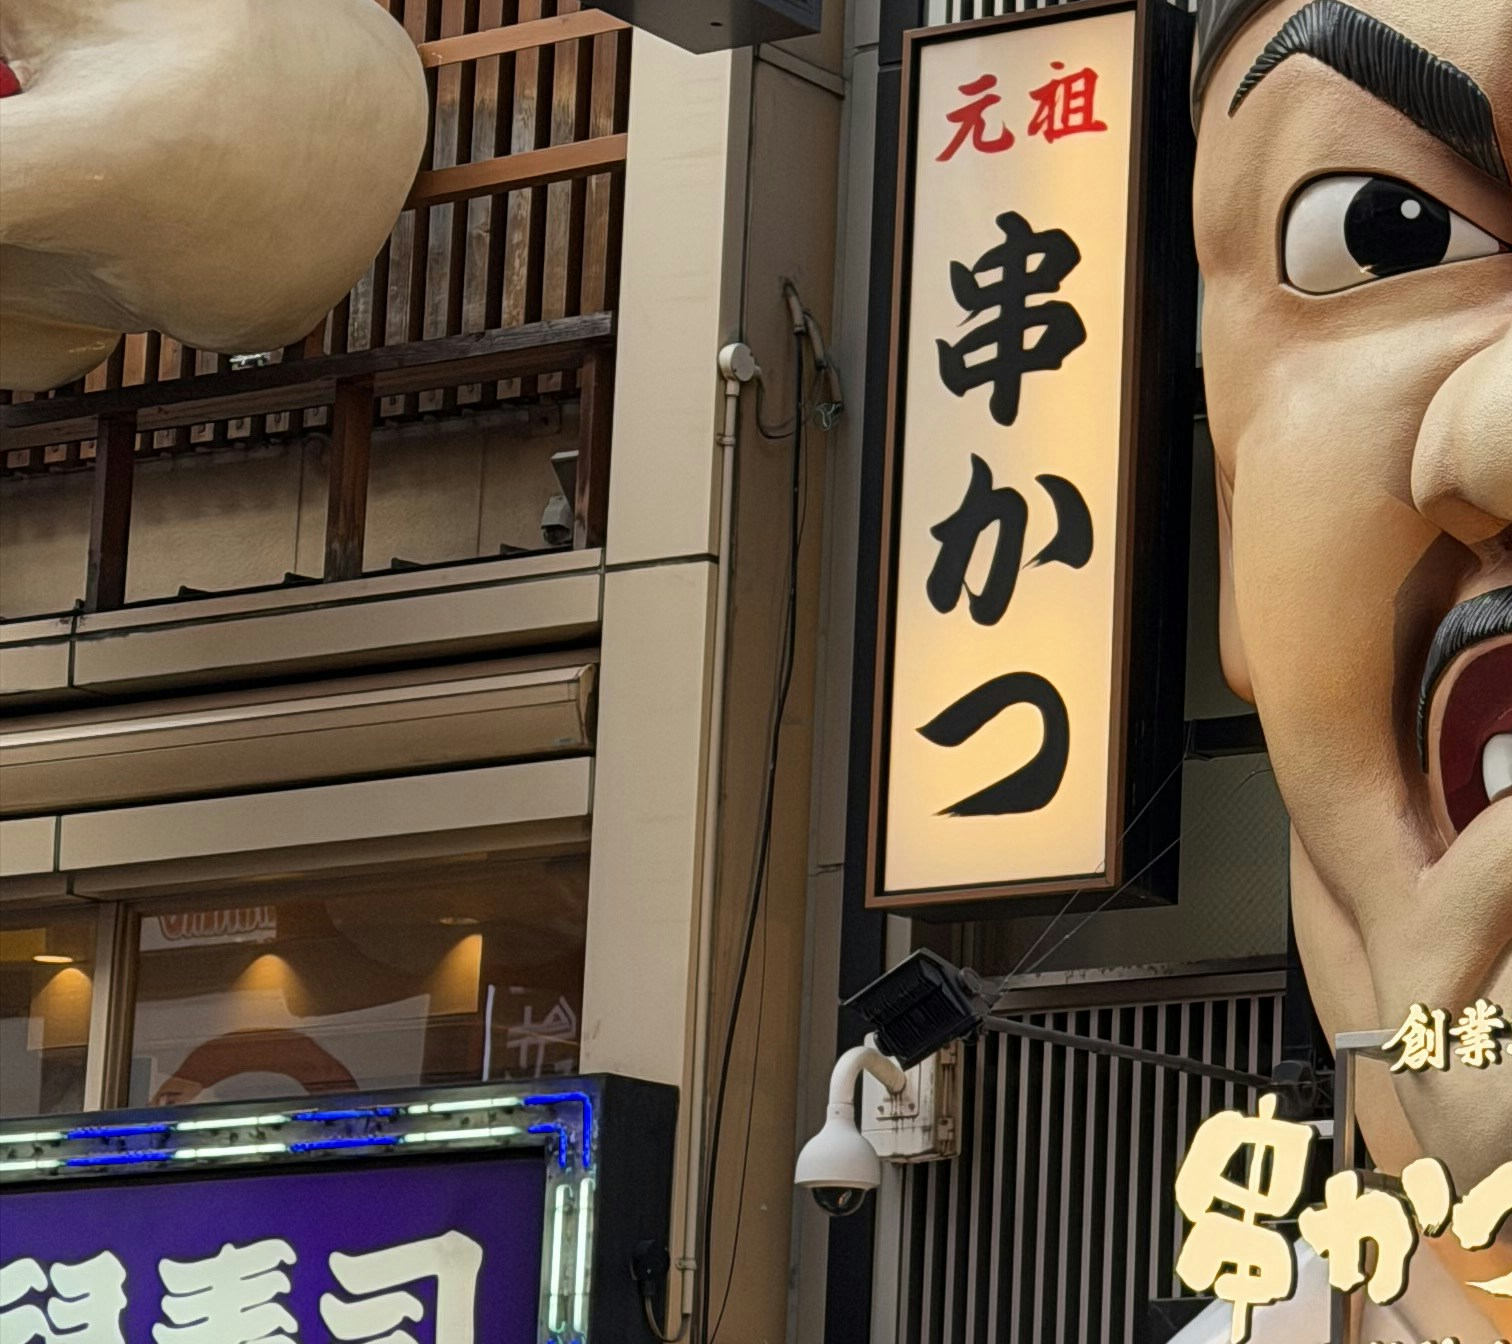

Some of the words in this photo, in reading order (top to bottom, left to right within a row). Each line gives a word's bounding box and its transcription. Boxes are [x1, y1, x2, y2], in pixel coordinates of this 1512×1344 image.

[935, 61, 1109, 163] 元祖
[915, 210, 1095, 818] 串かつ
